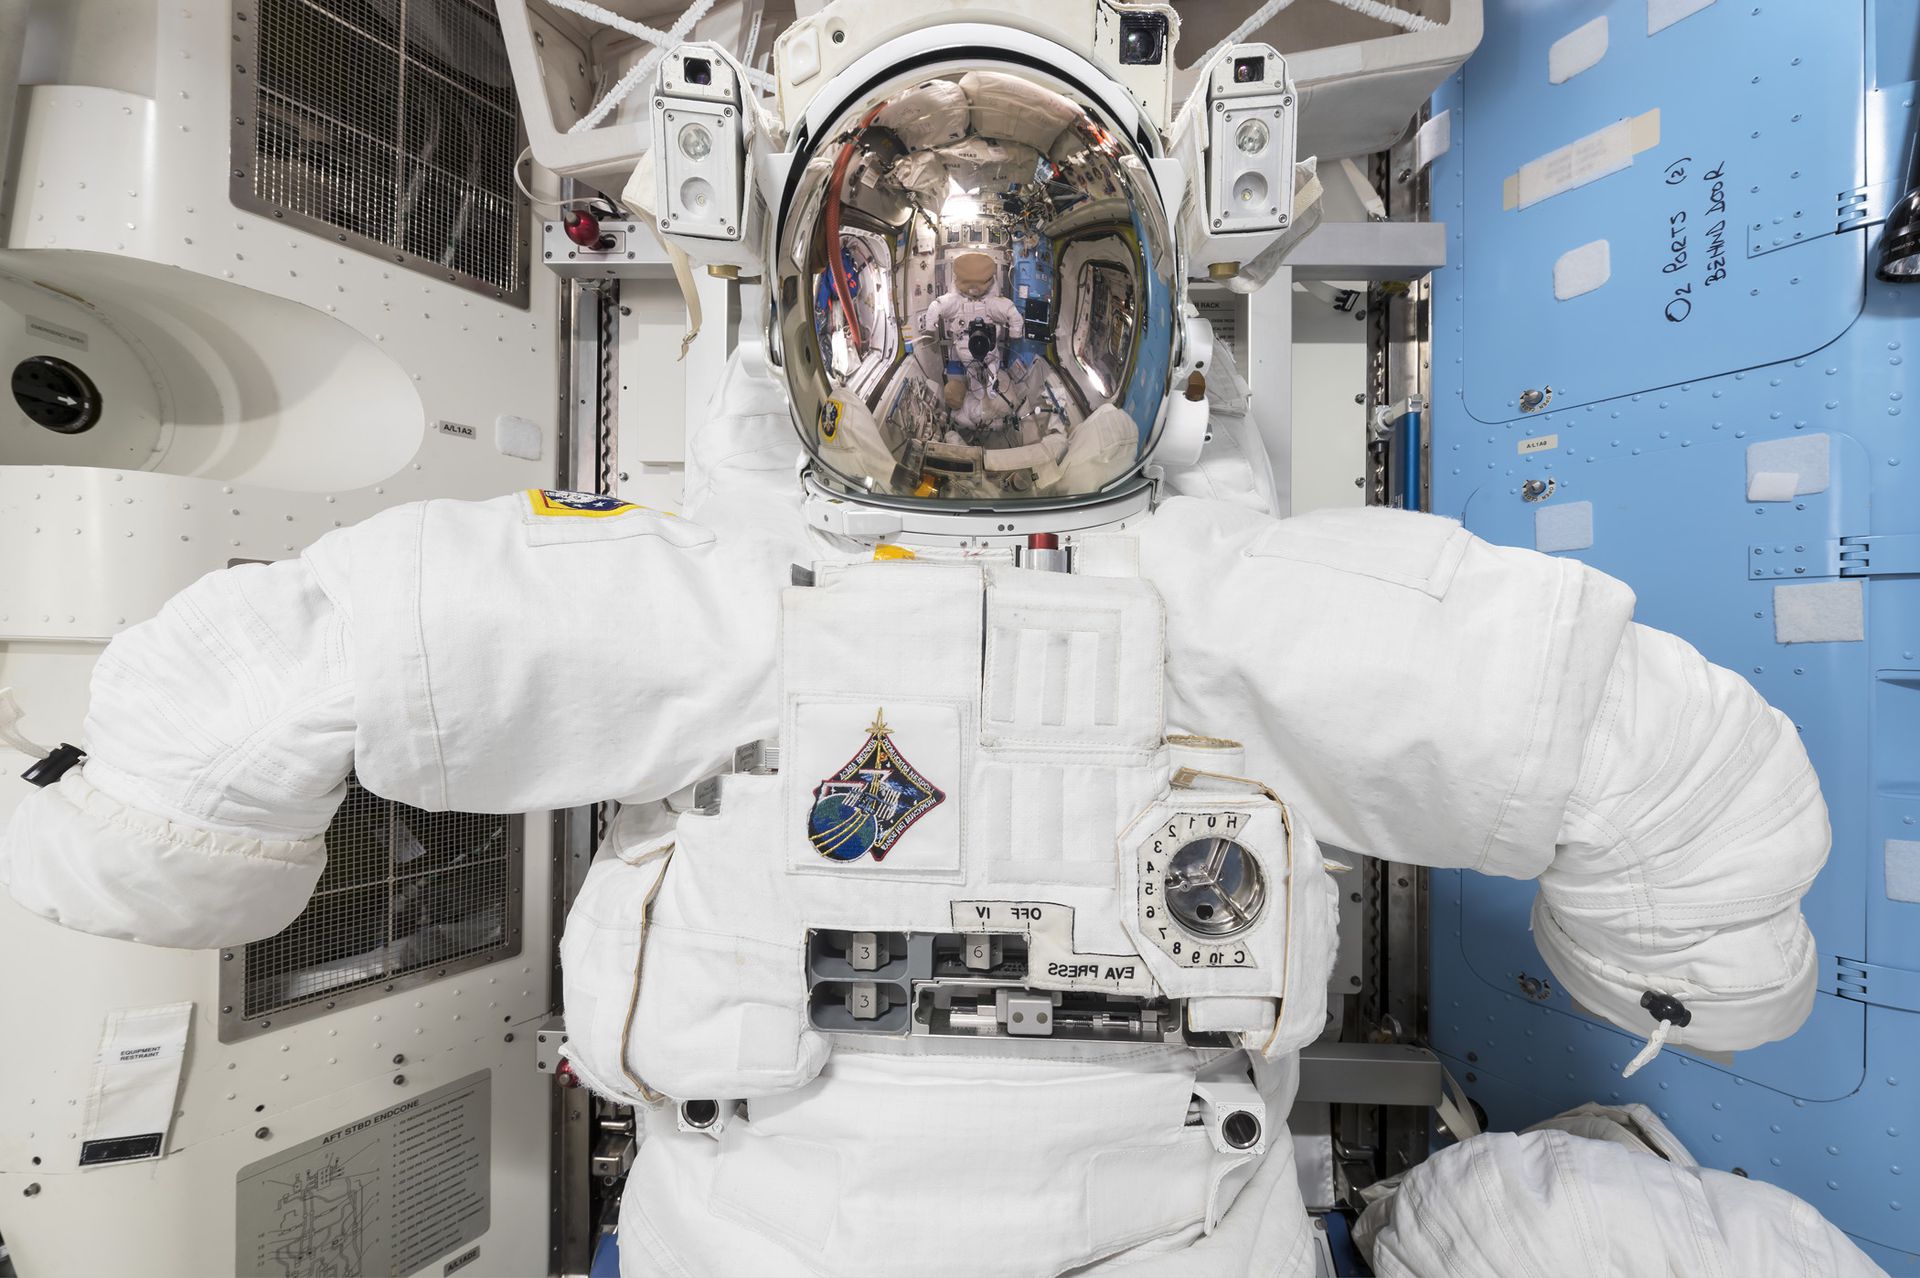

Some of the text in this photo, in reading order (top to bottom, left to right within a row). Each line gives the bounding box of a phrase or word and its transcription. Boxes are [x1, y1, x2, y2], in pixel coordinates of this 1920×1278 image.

[1664, 157, 1692, 185] (2)
[1703, 160, 1726, 216] DOOR
[1662, 210, 1688, 274] PORTS
[443, 423, 473, 436] A/L1A2
[860, 946, 870, 960] 3
[973, 945, 983, 959] 6
[859, 994, 870, 1008] 3
[120, 1046, 161, 1055] EQUIPMENT
[120, 1051, 159, 1060] RESTRAINT
[322, 1131, 342, 1145] AFT
[344, 1119, 371, 1136] STBD
[374, 1099, 420, 1124] ENDCONE
